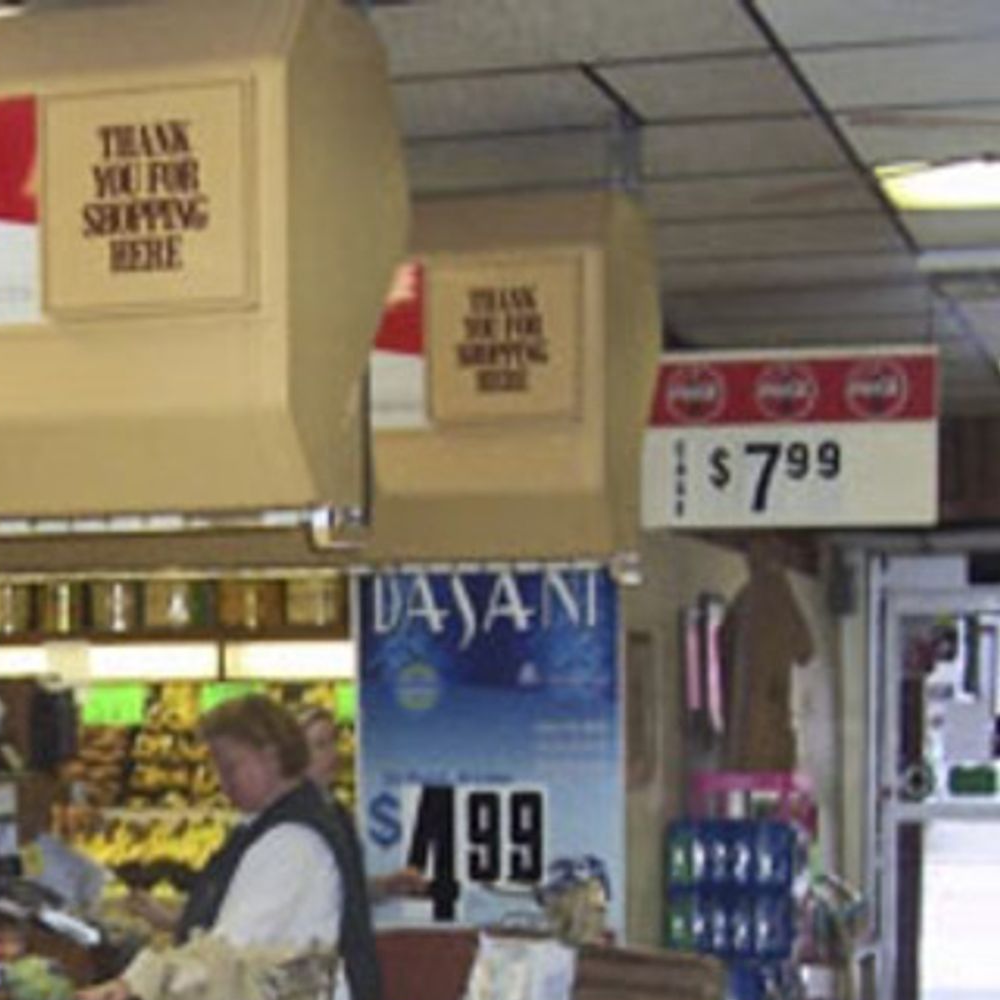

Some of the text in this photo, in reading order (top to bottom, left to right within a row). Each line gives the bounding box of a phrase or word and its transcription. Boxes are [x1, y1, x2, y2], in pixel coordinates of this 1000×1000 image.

[99, 121, 192, 158] THANK
[92, 159, 199, 200] YOU FOR
[82, 196, 210, 238] SHOPPING
[109, 236, 183, 274] HERE
[371, 569, 598, 650] DASANI
